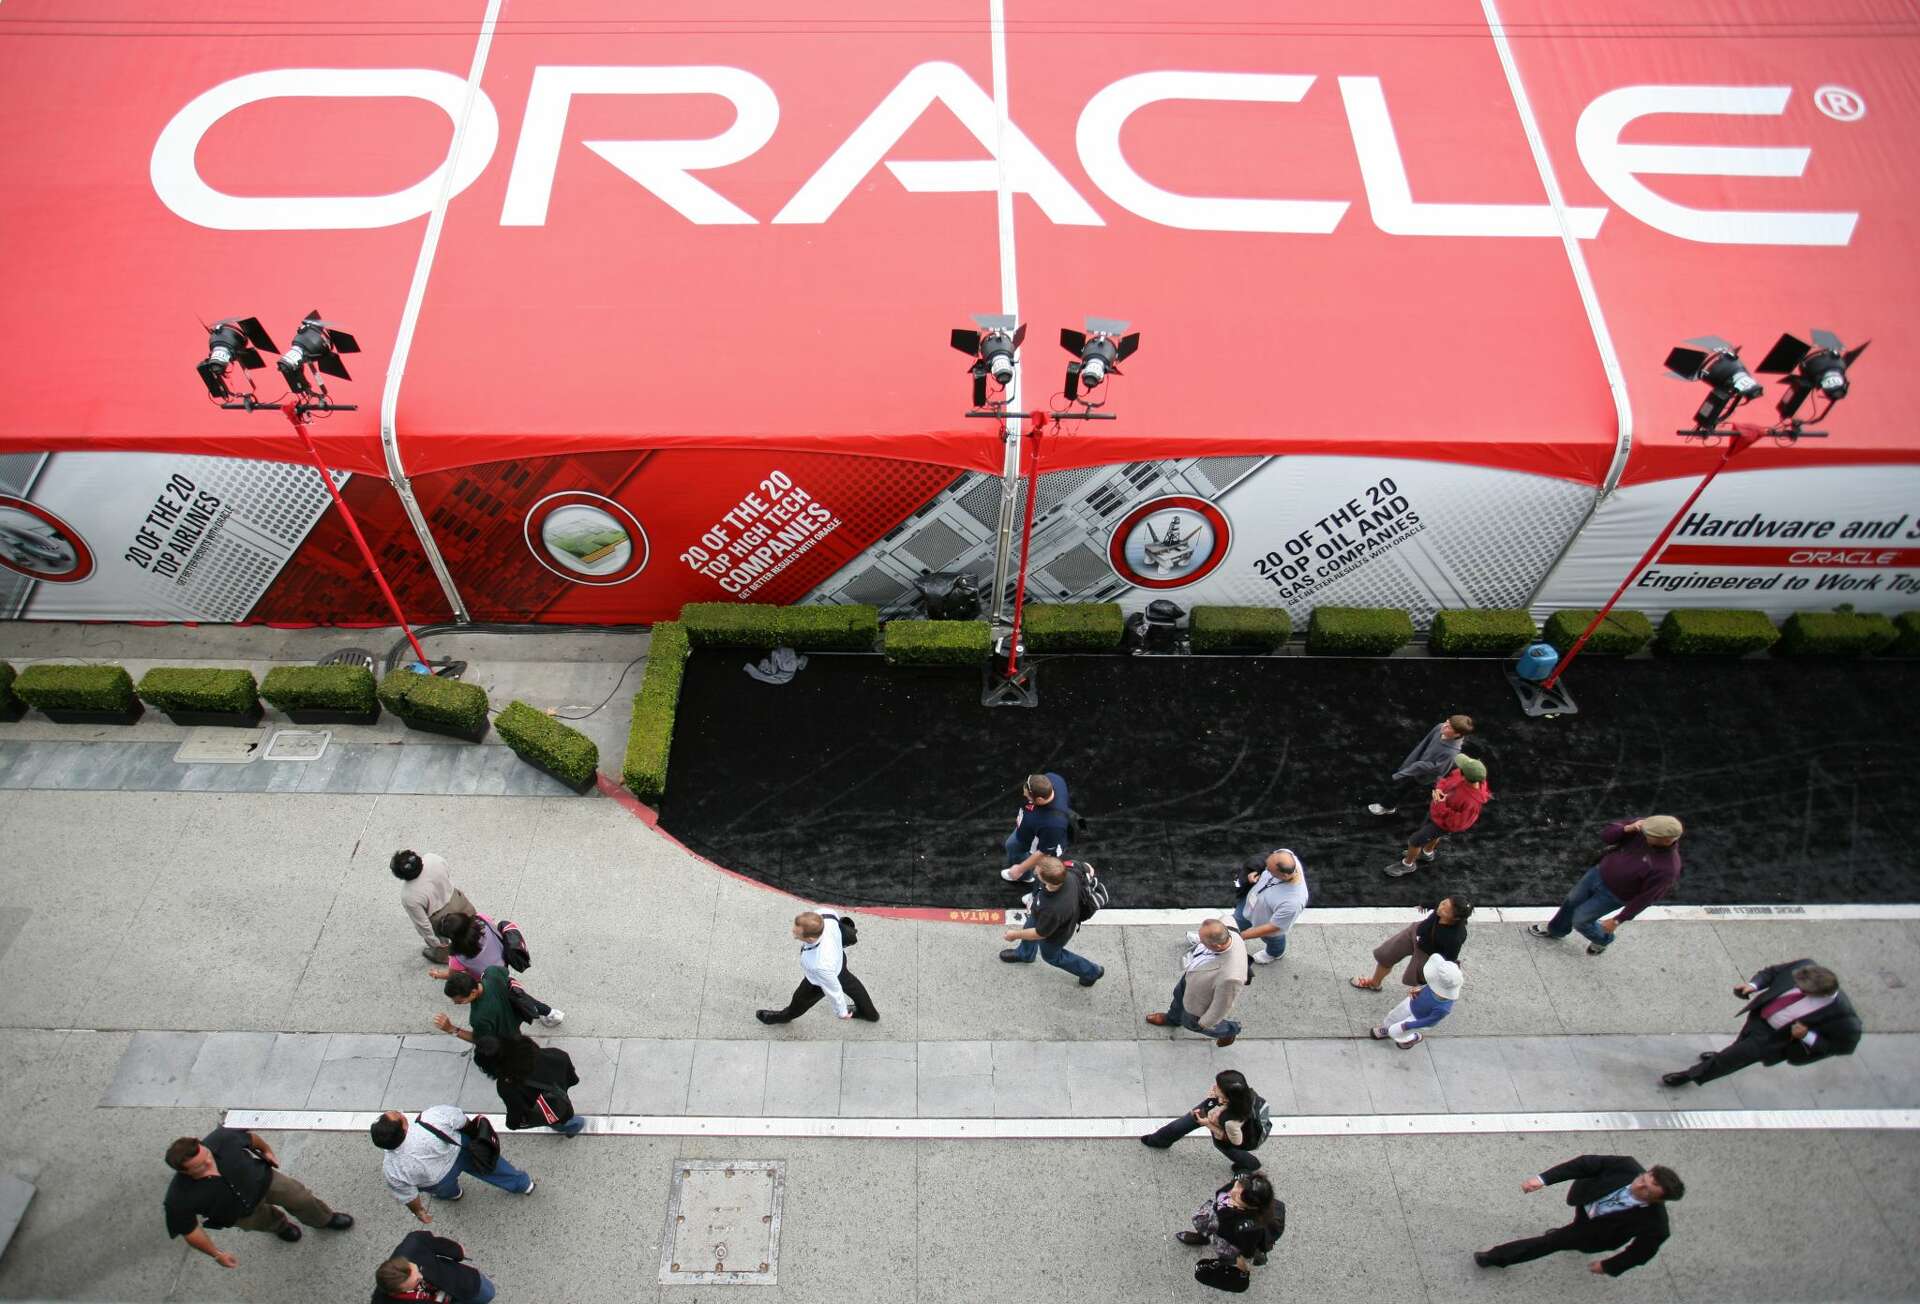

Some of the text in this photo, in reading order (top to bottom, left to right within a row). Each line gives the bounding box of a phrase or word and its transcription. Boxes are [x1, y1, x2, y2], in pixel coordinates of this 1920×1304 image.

[149, 61, 1859, 246] ORACLE
[124, 473, 196, 569] 20 OF THE 20
[152, 490, 220, 578] TOP AIRLINES
[215, 504, 234, 528] ORACLE
[680, 470, 792, 570] 20 OF THE 20
[699, 487, 812, 579] TOP HIGH TECH
[719, 502, 831, 593] COMPANIES
[738, 517, 842, 600] GET BETTER RESULTS WITH ORACLE
[1253, 477, 1398, 576] 20 OF THE 20
[1265, 495, 1409, 587] TOP OIL AND
[1279, 511, 1420, 599] GAS COMPANIES
[1676, 512, 1835, 539] Hardware
[1839, 514, 1908, 539] and
[1787, 551, 1897, 564] ORACLE
[1288, 523, 1426, 606] GET BETTER RESULTS WITH ORACLE
[1637, 570, 1783, 592] Engineered
[1782, 574, 1809, 591] to
[1814, 573, 1884, 591] Work
[960, 911, 989, 921] MTA
